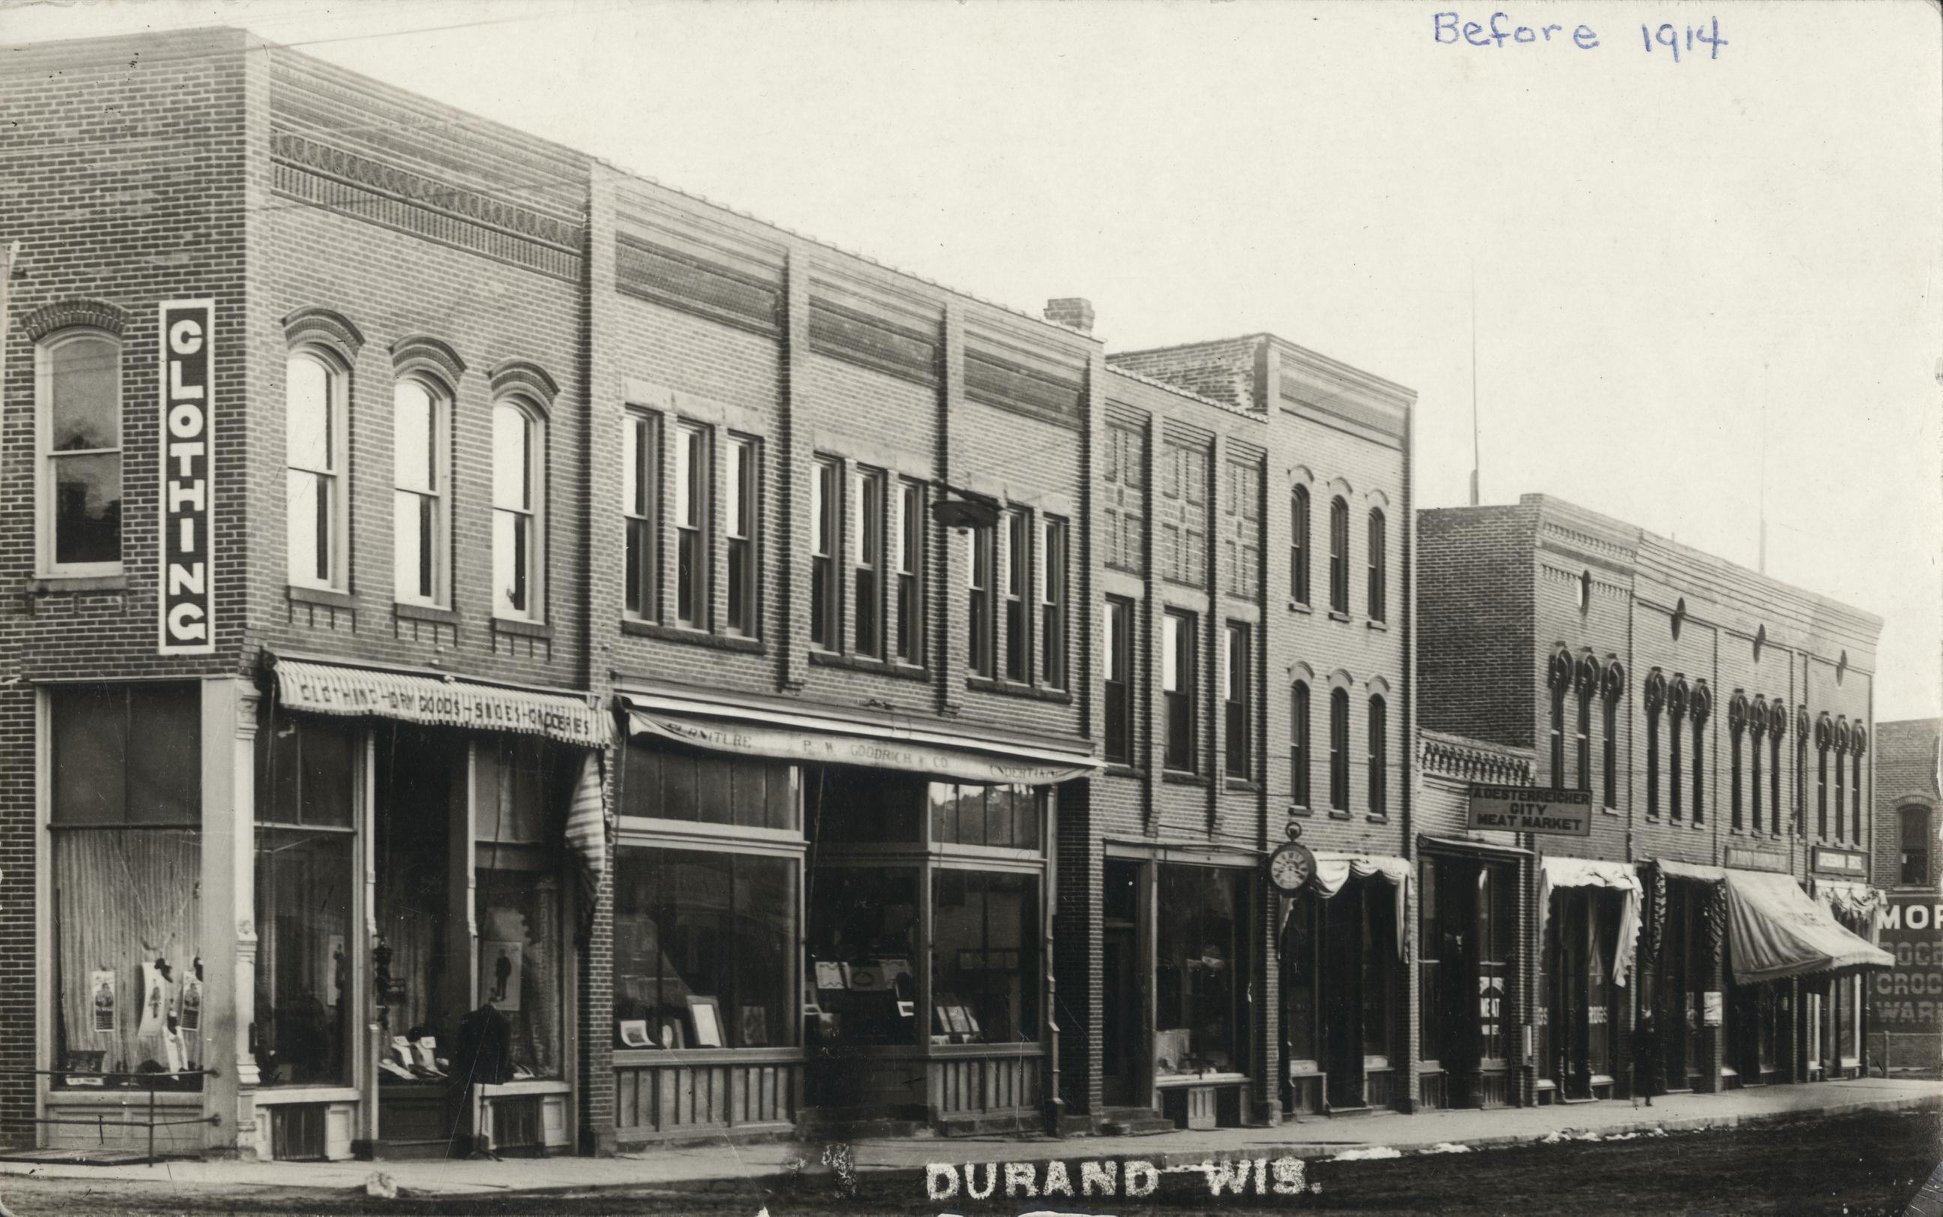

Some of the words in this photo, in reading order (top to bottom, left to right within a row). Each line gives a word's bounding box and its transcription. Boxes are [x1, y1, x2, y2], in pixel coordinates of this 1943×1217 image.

[1432, 11, 1600, 49] Before
[1641, 15, 1729, 63] 1914
[168, 319, 207, 641] CLOTHING
[419, 694, 460, 717] GOODS
[1509, 802, 1548, 816] CITY
[1477, 814, 1518, 827] MEAT
[1522, 816, 1582, 830] MARKET
